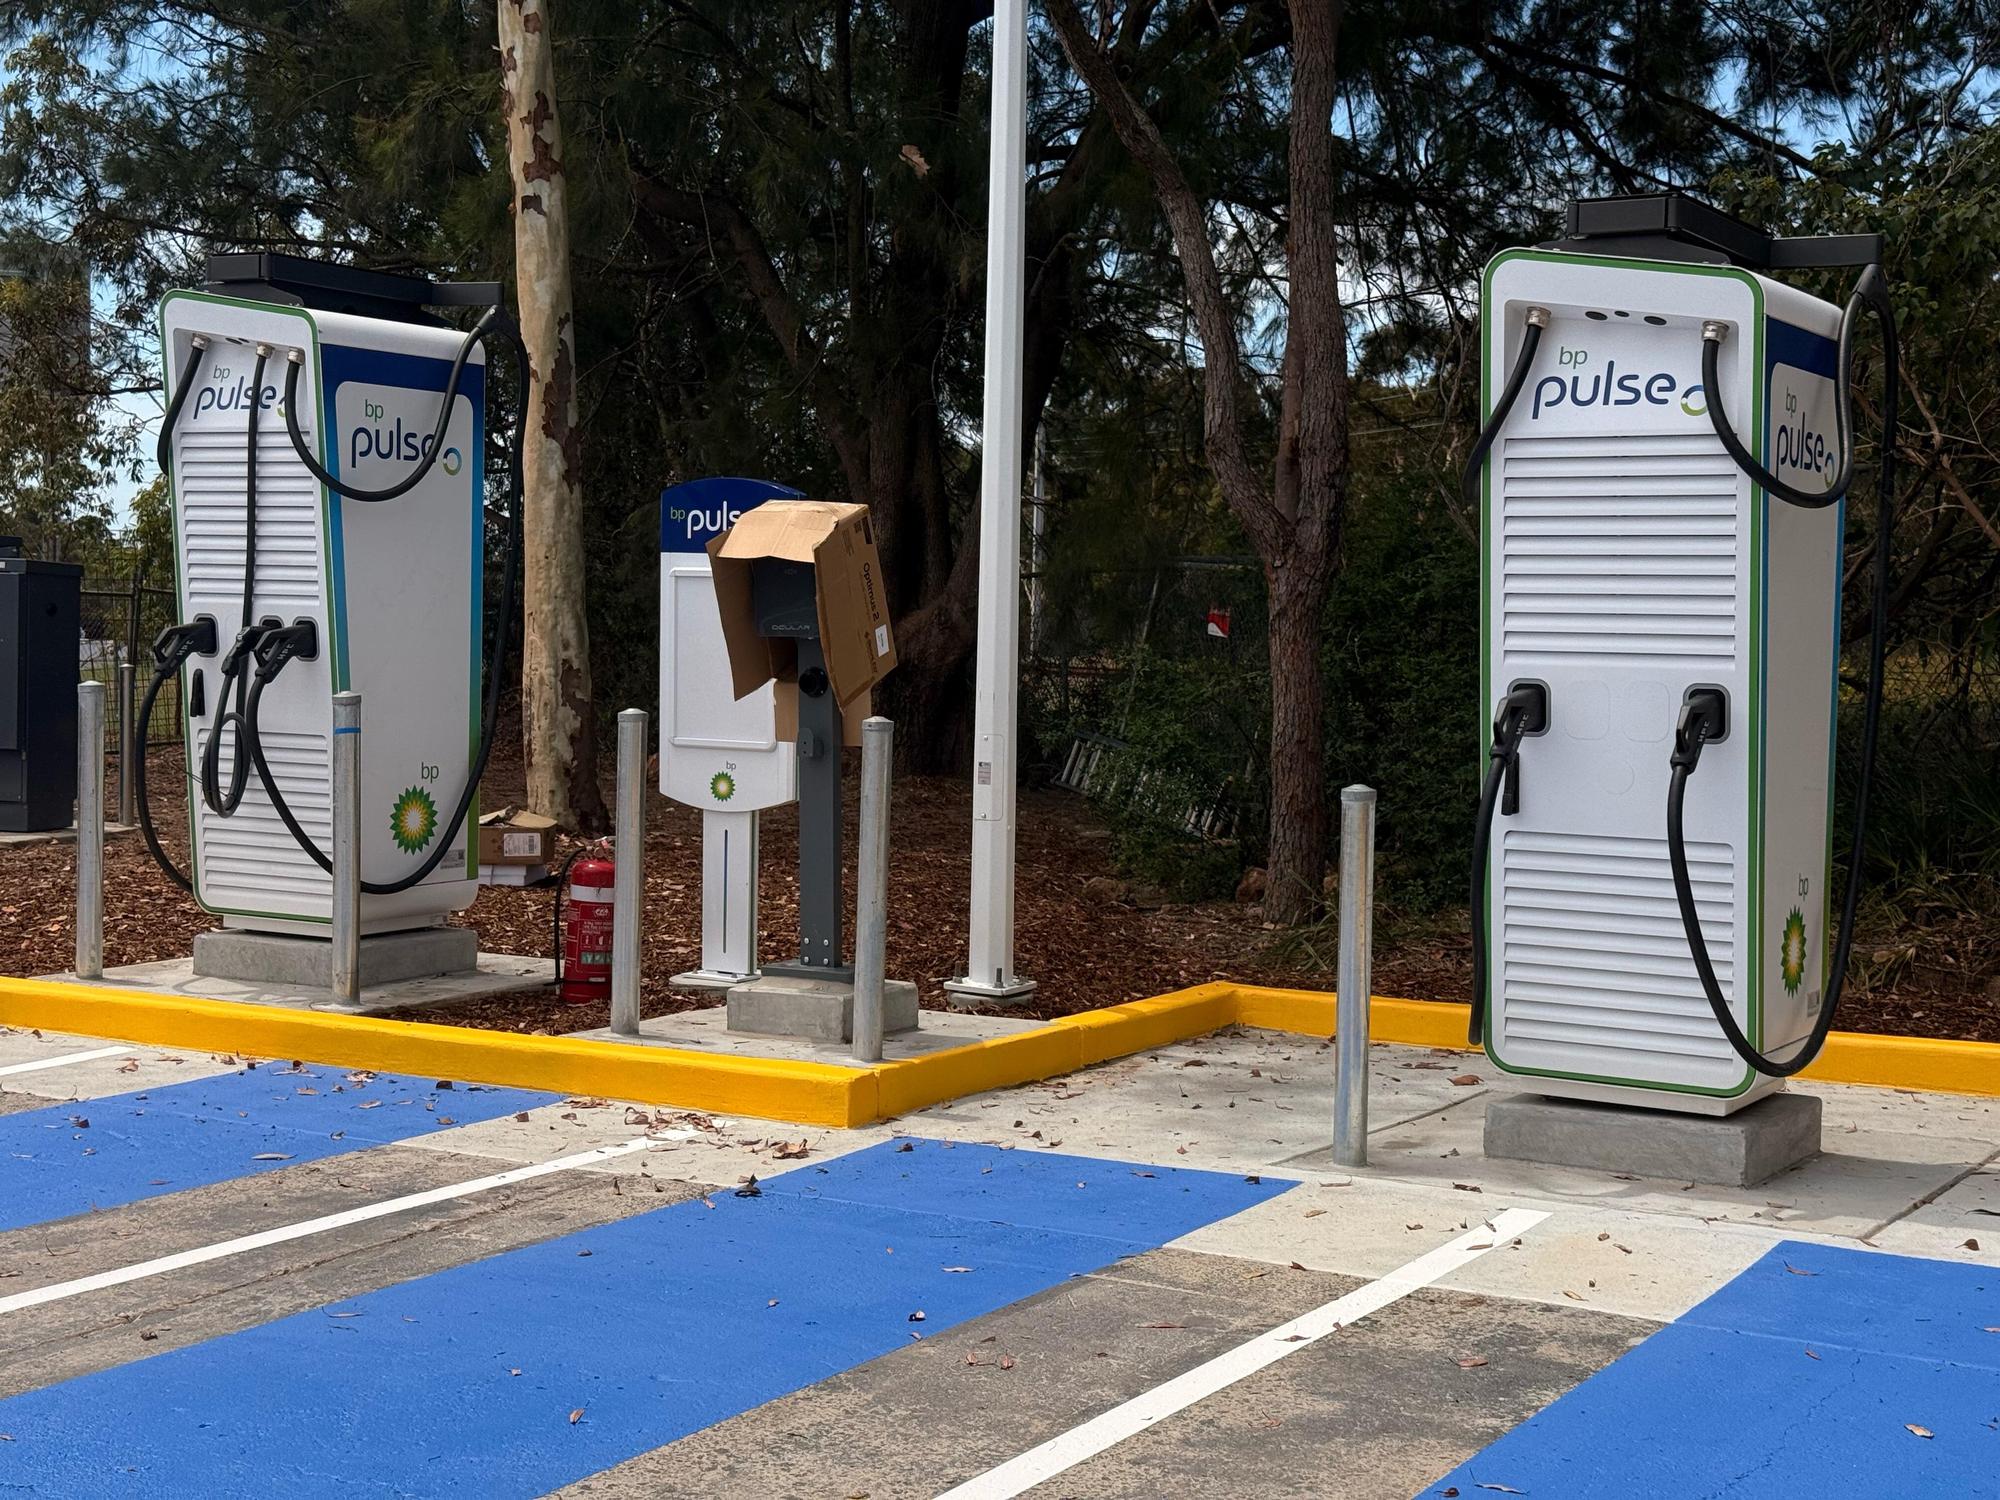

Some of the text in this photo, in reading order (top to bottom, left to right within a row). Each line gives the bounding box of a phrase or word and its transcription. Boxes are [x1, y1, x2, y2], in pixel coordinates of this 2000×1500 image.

[1559, 346, 1588, 369] bp
[213, 365, 231, 380] bp
[193, 376, 277, 420] pulse
[1532, 360, 1677, 420] pulse
[1785, 387, 1797, 413] bp
[364, 400, 384, 419] bp
[1776, 412, 1824, 481] pulse
[670, 500, 742, 539] bp puls
[863, 562, 877, 611] Optimus
[421, 762, 440, 784] bp
[726, 760, 737, 772] bp
[1798, 873, 1809, 901] bp
